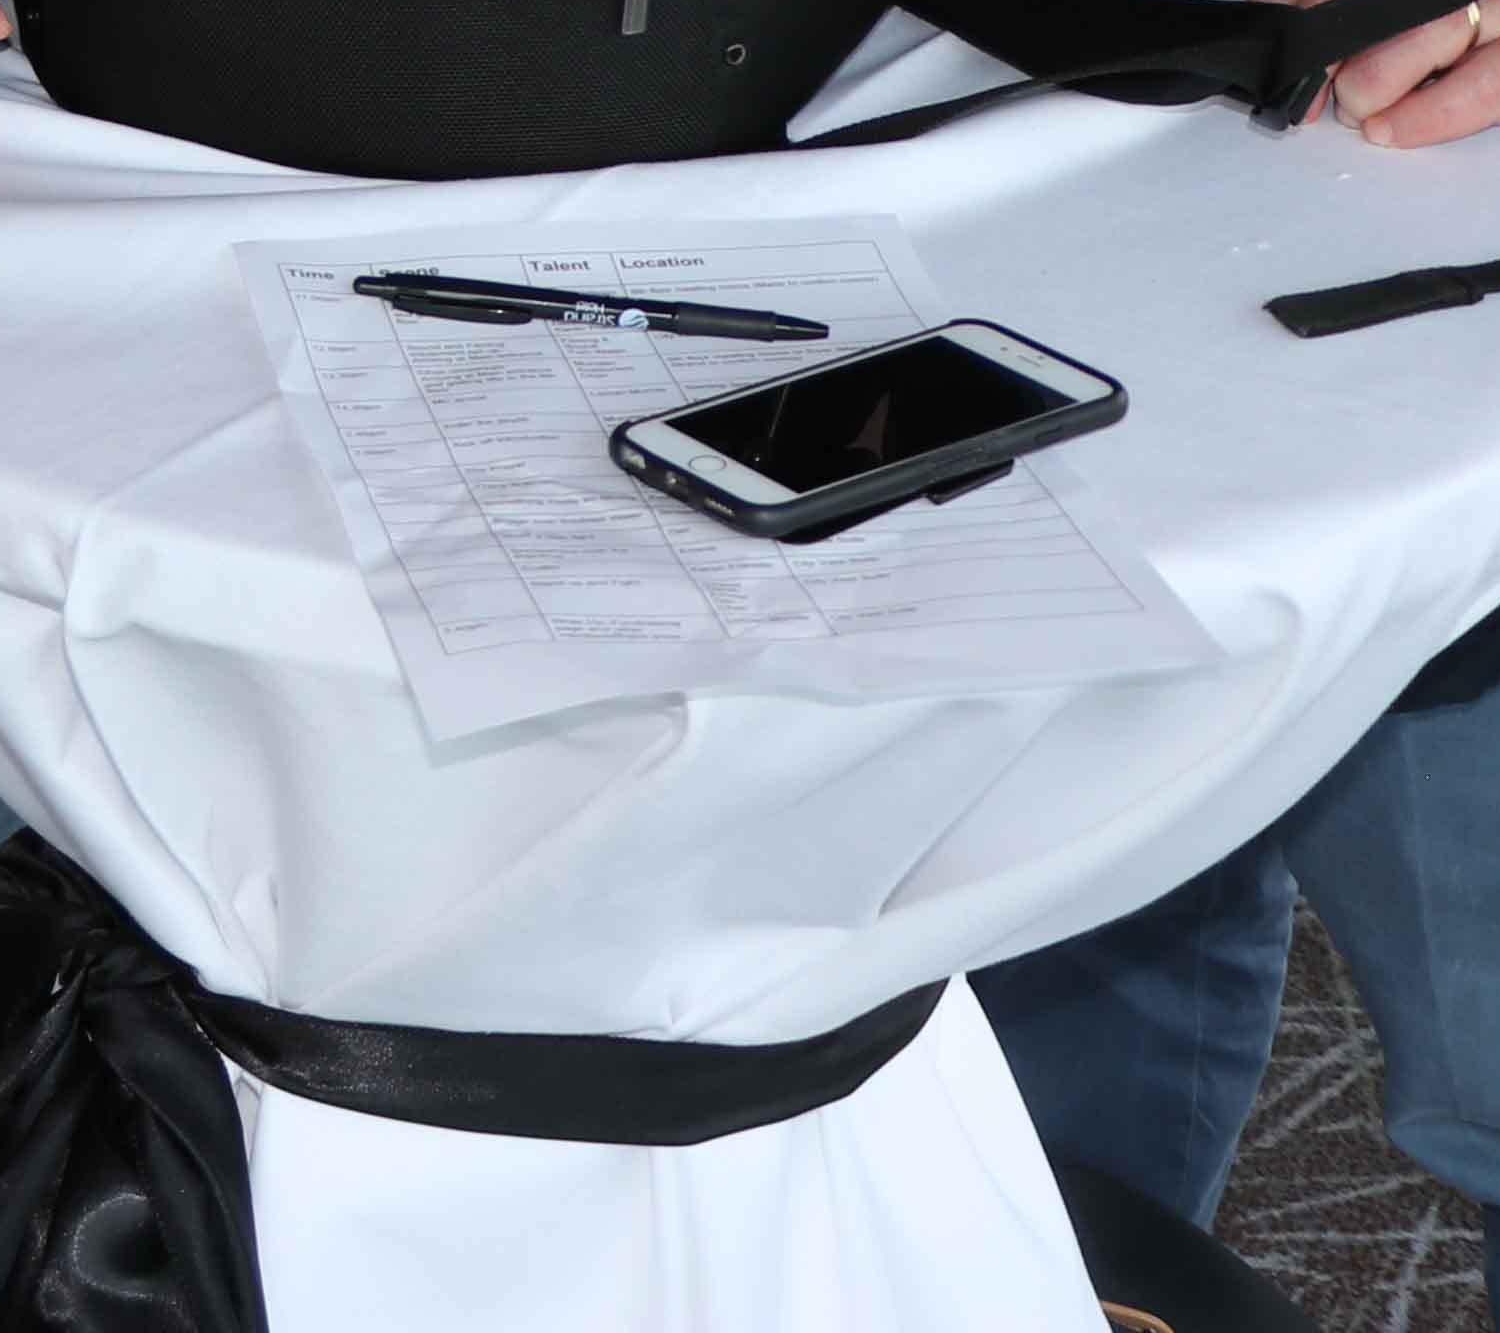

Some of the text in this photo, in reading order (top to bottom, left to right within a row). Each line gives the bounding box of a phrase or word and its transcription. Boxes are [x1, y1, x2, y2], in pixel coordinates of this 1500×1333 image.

[287, 268, 335, 281] Time
[530, 259, 591, 272] Talent
[619, 256, 705, 271] Location
